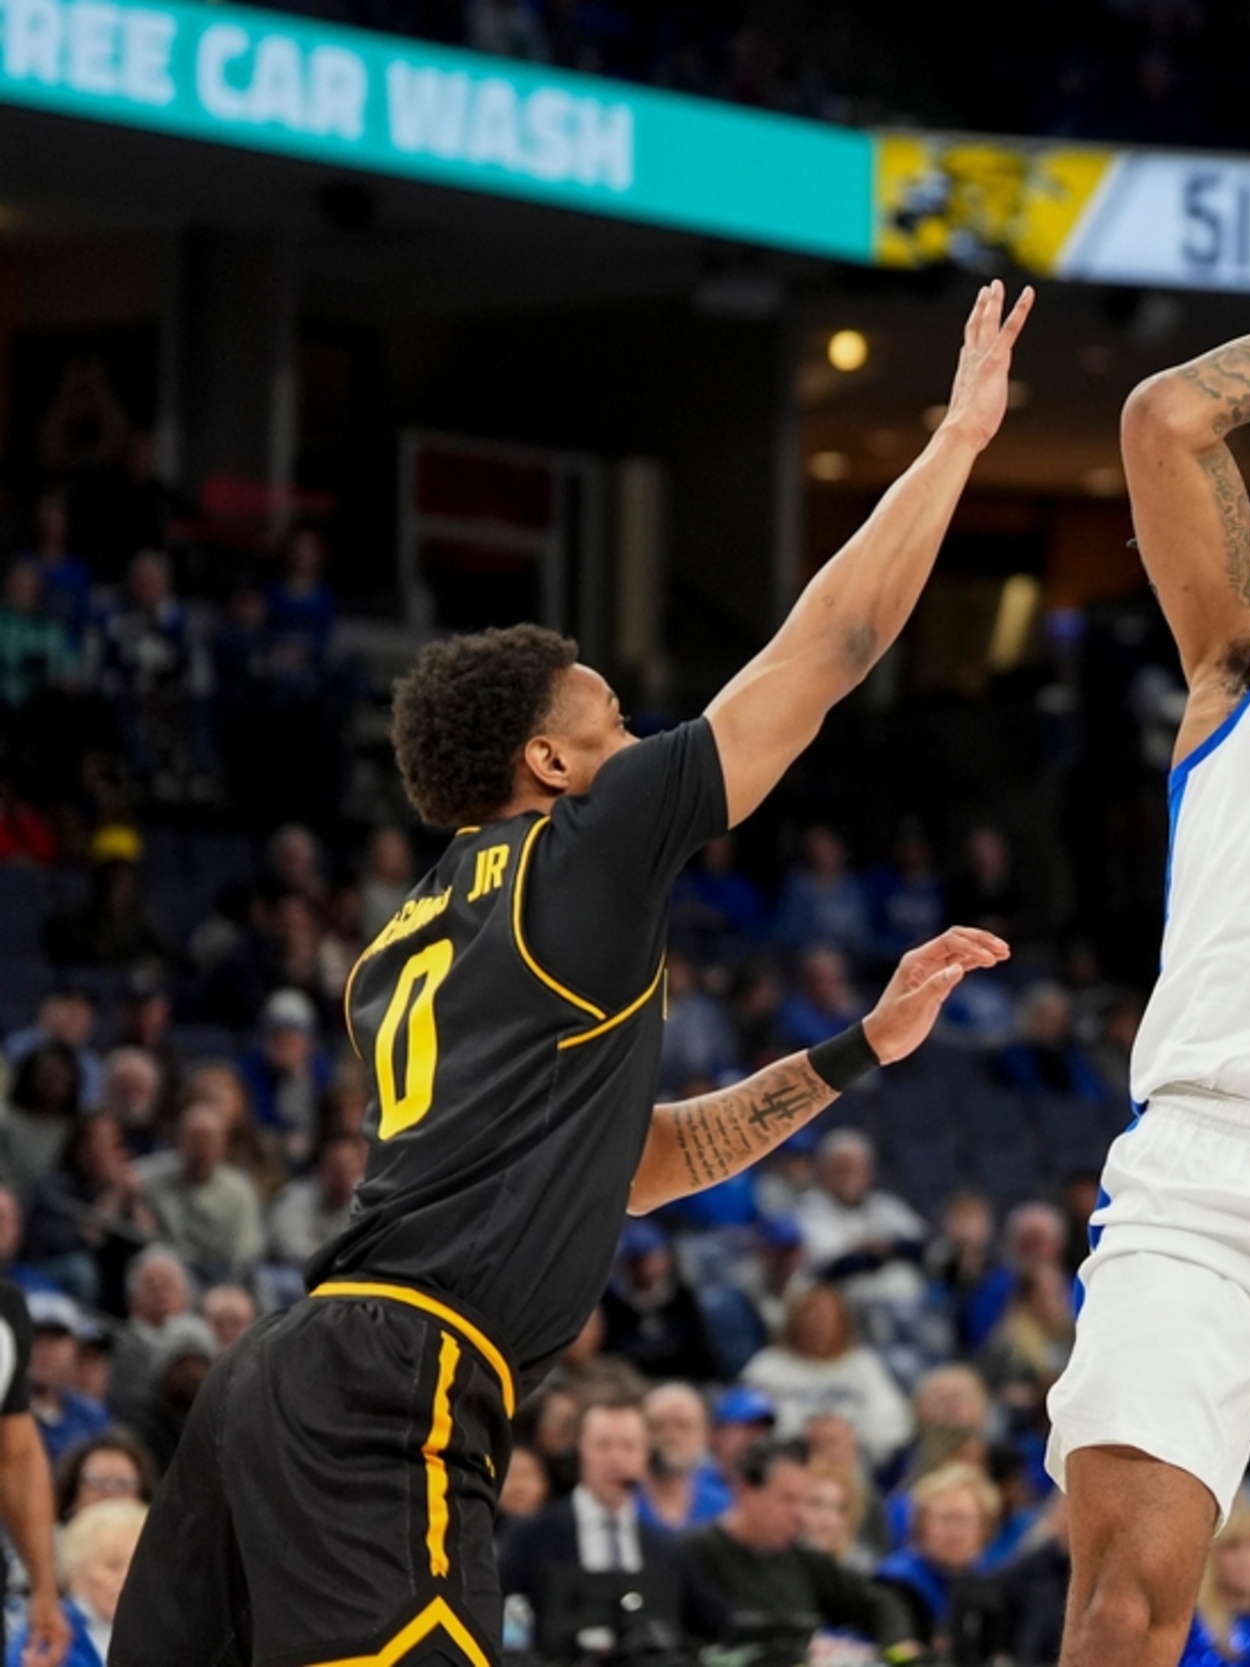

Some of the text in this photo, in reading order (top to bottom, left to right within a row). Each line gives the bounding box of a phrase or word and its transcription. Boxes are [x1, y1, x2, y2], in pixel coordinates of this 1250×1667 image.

[197, 24, 367, 142] CAR
[387, 60, 634, 192] WASH
[467, 843, 510, 903] JR
[375, 937, 453, 1142] 0
